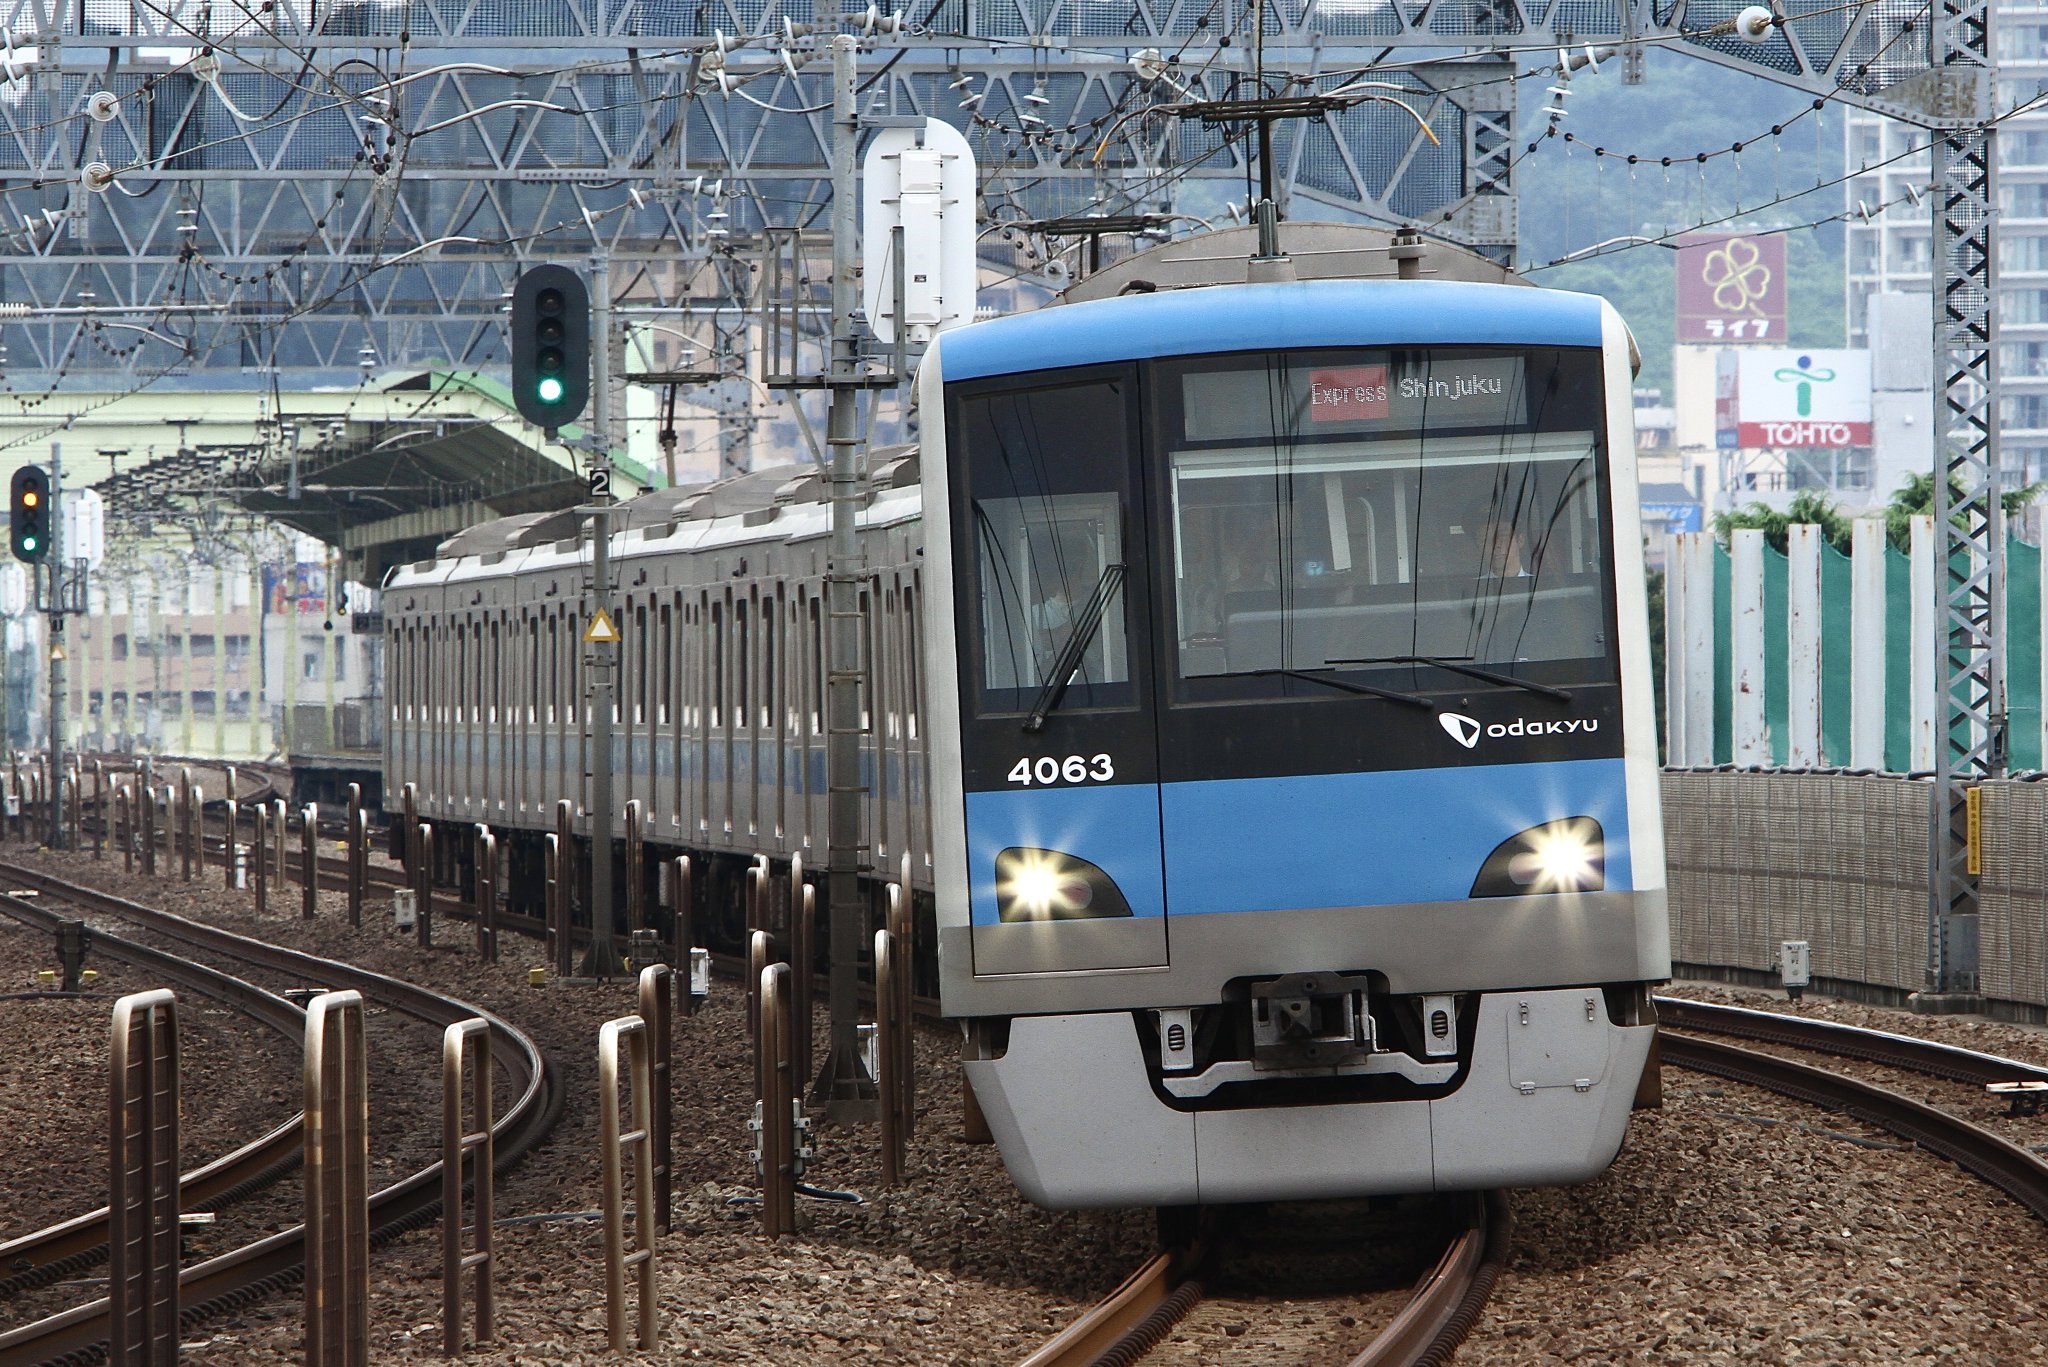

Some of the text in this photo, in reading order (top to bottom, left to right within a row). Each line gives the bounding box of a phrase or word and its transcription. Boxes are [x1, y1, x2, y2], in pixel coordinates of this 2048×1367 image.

[1705, 319, 1769, 338] ライフ
[1312, 374, 1501, 406] Express Shinjuku
[1760, 422, 1851, 445] TOHTO
[591, 471, 609, 496] 2
[1486, 717, 1598, 738] odakyu
[1007, 753, 1115, 786] 4063
